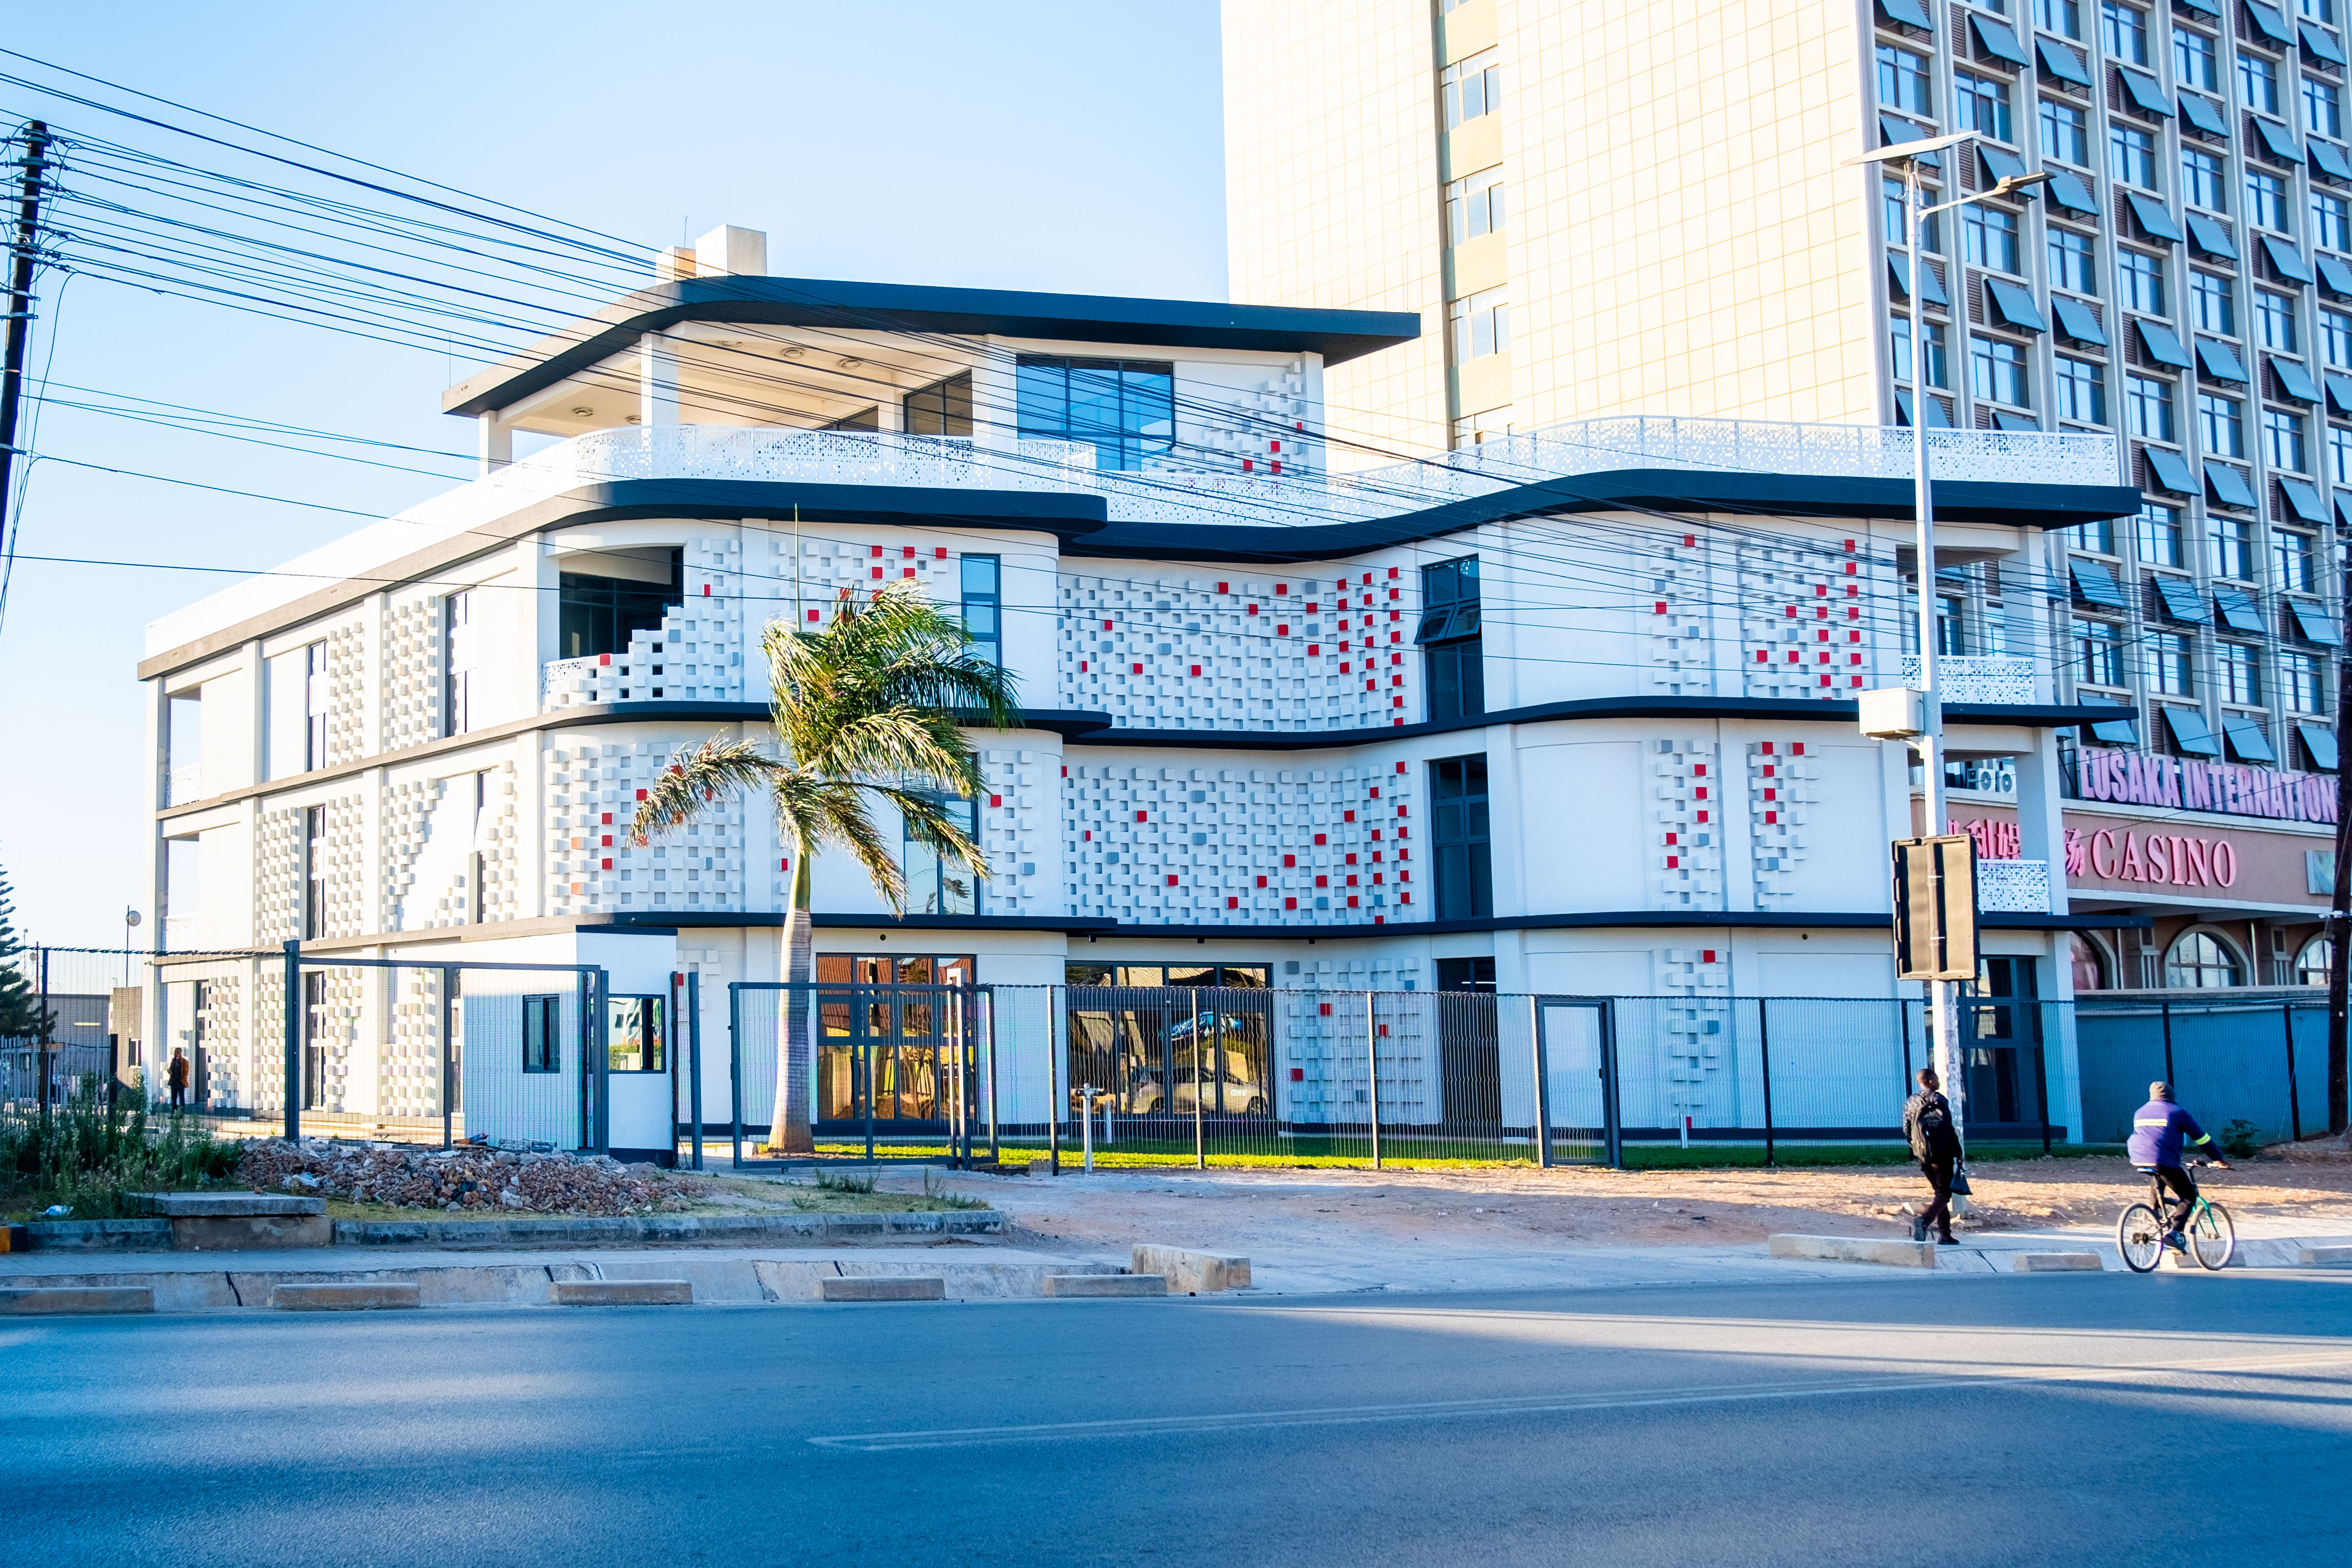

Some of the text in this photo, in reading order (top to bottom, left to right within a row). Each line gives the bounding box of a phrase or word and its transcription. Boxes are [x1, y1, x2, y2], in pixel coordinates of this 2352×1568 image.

[2079, 749, 2338, 823] LUSAKA INTERNATION
[2090, 829, 2237, 888] CASINO
